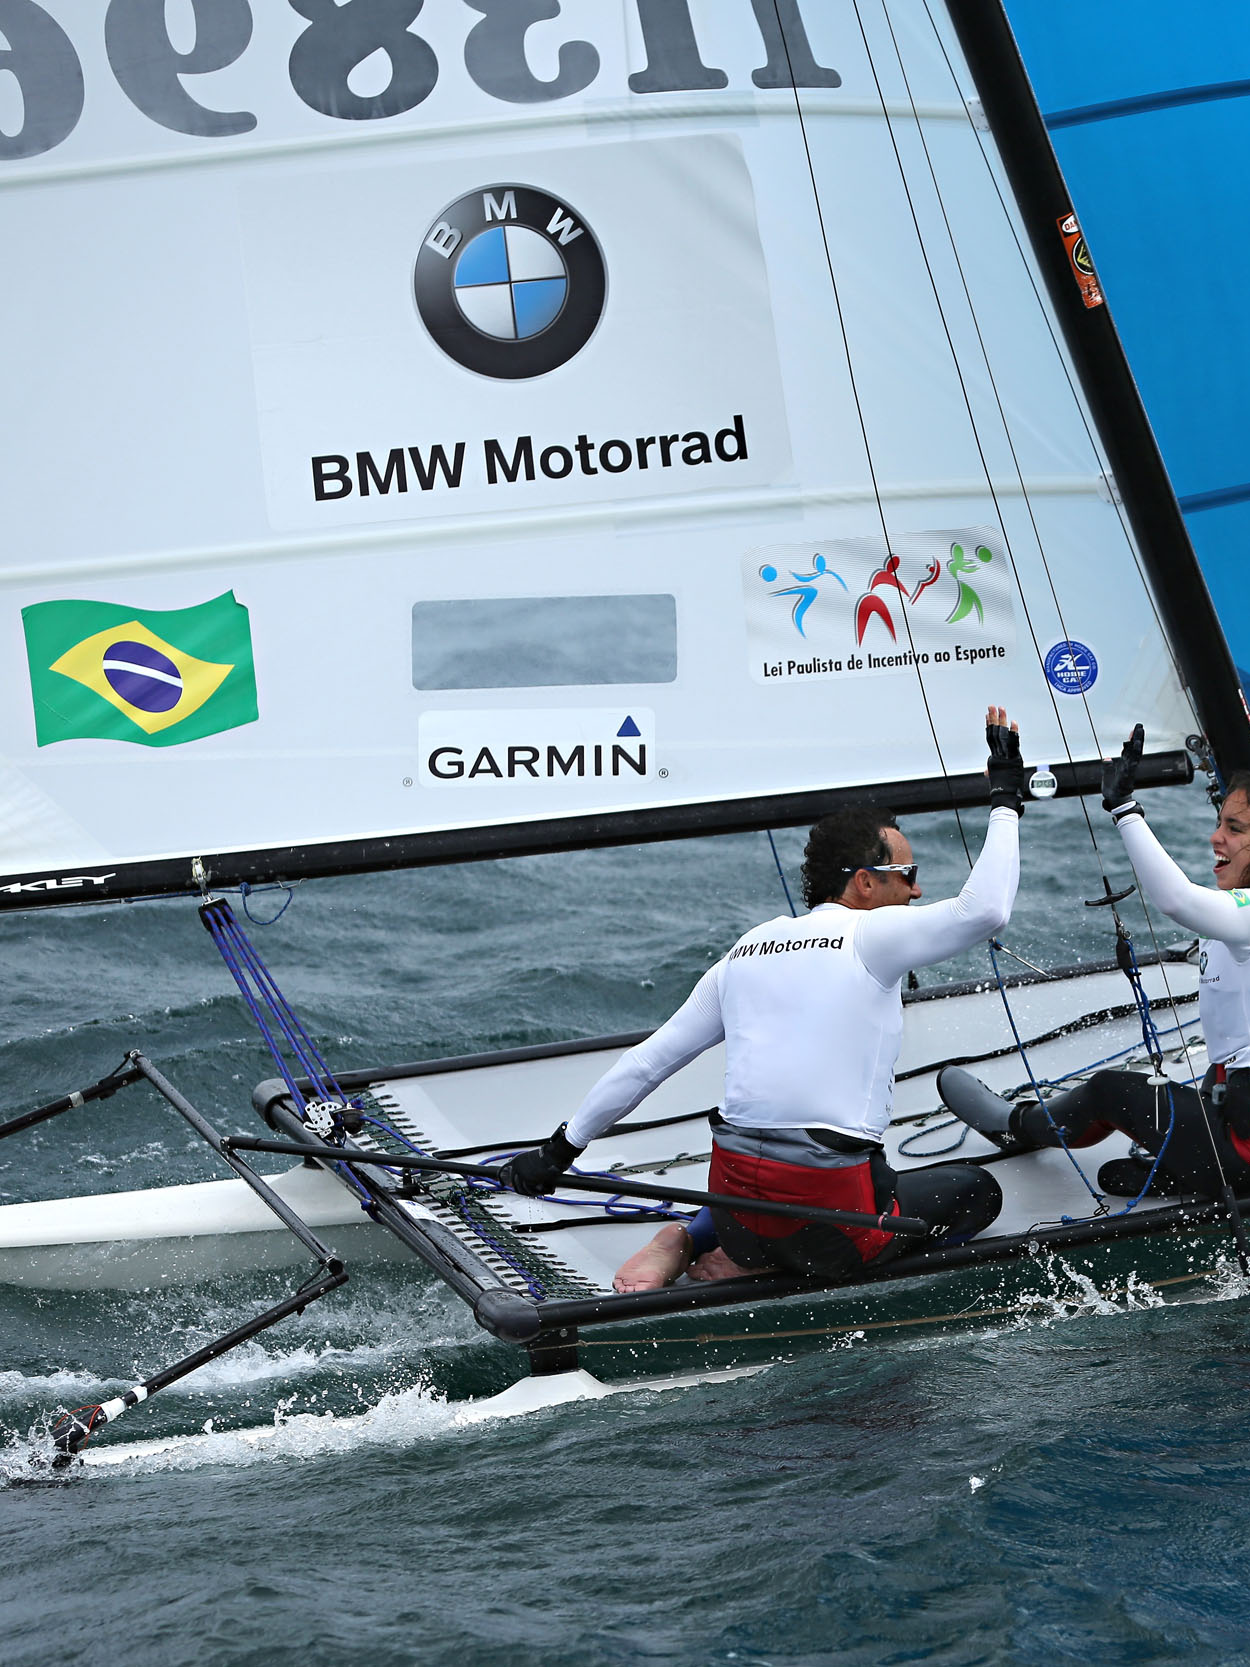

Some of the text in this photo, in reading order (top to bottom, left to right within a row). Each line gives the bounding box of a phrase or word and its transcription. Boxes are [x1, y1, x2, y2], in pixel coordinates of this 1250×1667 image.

[425, 190, 585, 260] BMW
[312, 414, 749, 502] BMW Motorrad
[763, 644, 1006, 677] Lei Paulista de Incentivo ao Esporte
[428, 744, 647, 779] GARMIN
[0, 873, 117, 893] AKLEY
[758, 936, 844, 954] Motorrad
